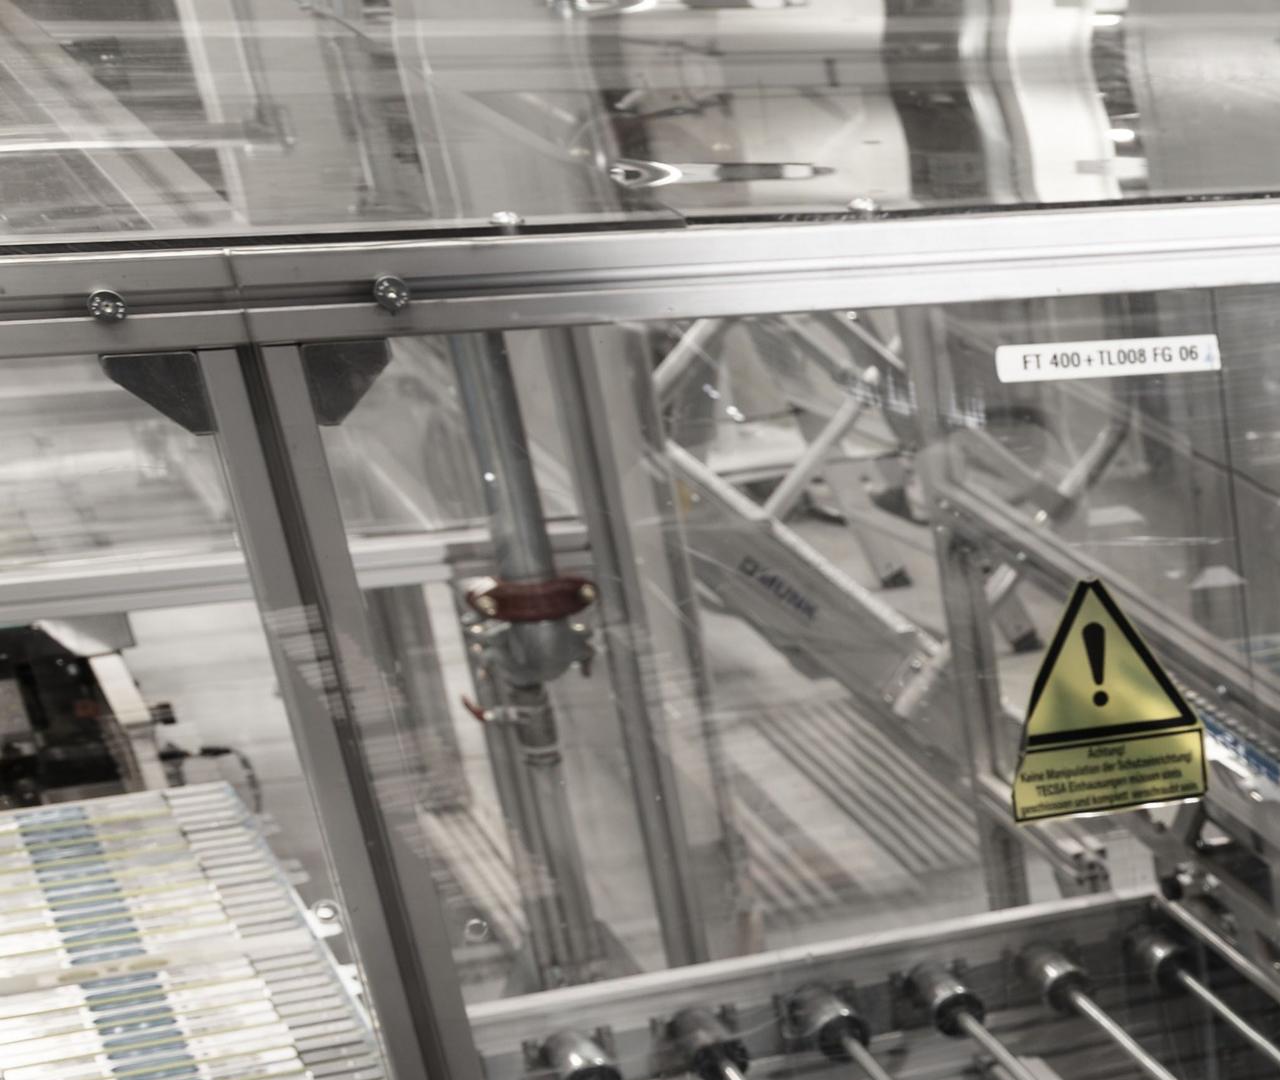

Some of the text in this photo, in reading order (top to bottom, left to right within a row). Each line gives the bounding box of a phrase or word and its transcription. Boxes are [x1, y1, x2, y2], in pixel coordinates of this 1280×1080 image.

[1022, 353, 1042, 371] FT
[1152, 346, 1173, 363] FG
[1178, 344, 1199, 361] 06
